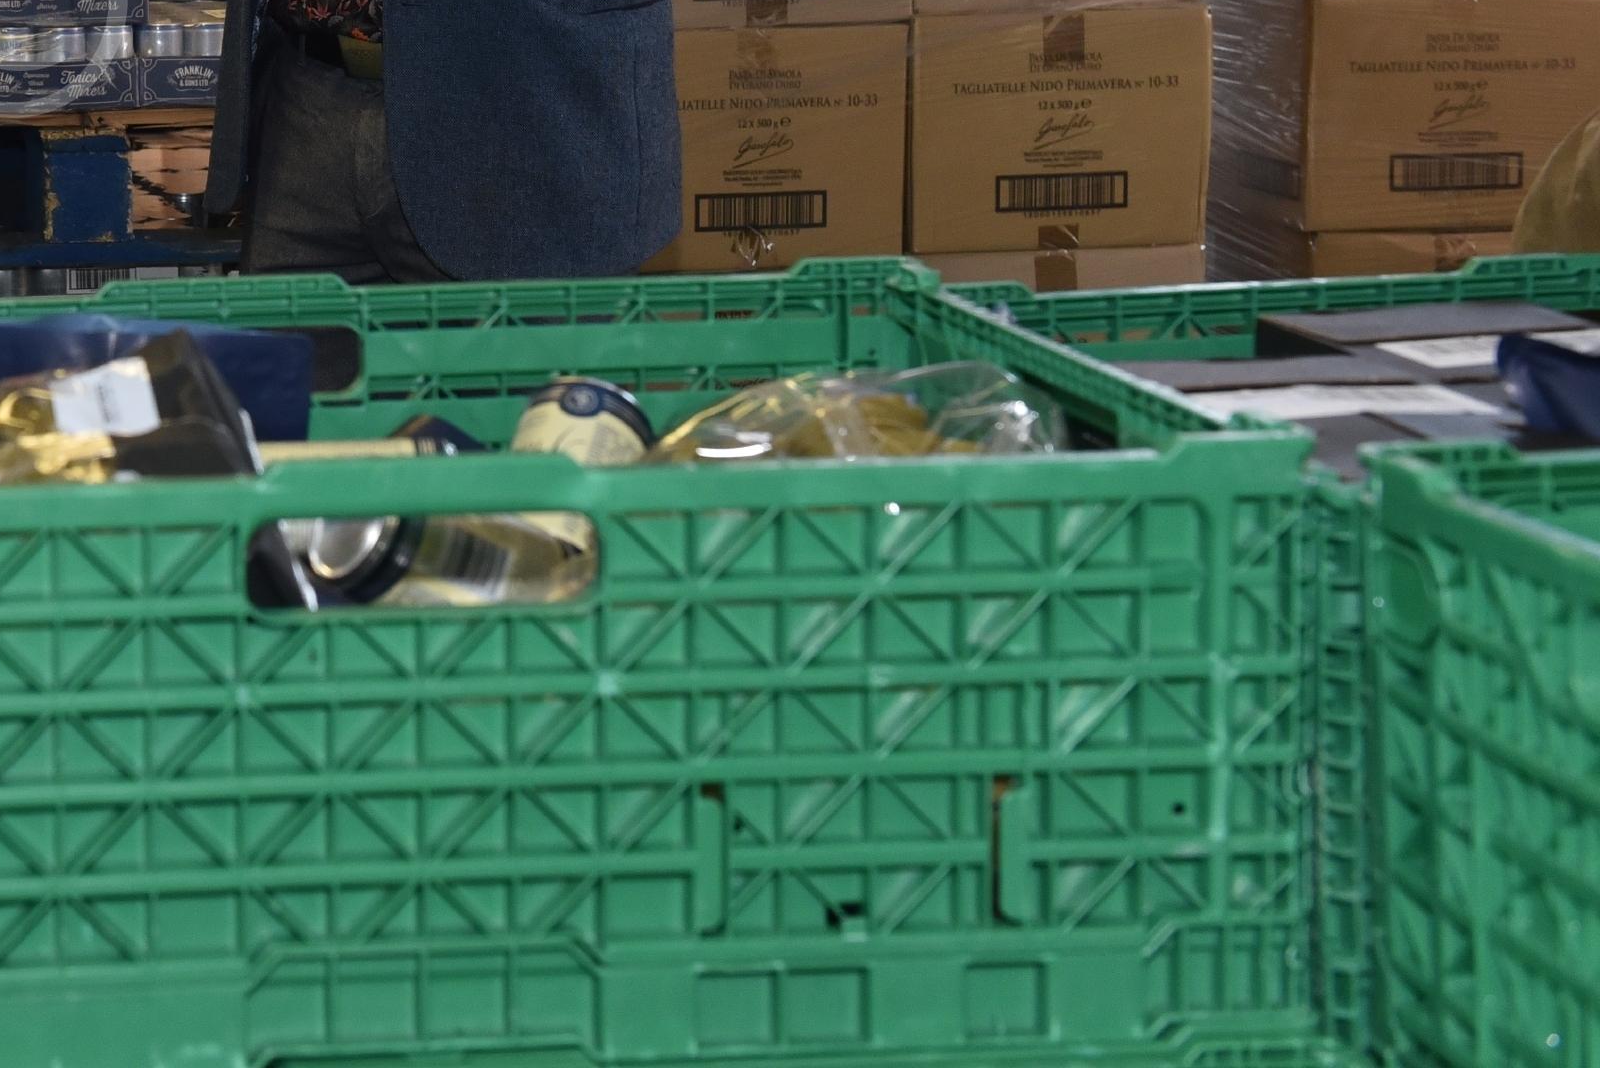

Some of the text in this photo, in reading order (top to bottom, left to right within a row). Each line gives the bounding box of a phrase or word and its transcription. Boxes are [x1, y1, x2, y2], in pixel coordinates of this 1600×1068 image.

[77, 0, 119, 14] Mixers
[60, 70, 97, 85] Tonics
[174, 66, 214, 80] FRANKLIN
[67, 83, 107, 99] Mixers
[953, 75, 1179, 95] TAGLIATELLE NIDO PRIMAVERA 10-33
[678, 94, 878, 111] LIATELLE NIDO PRIMAVERA 10-33
